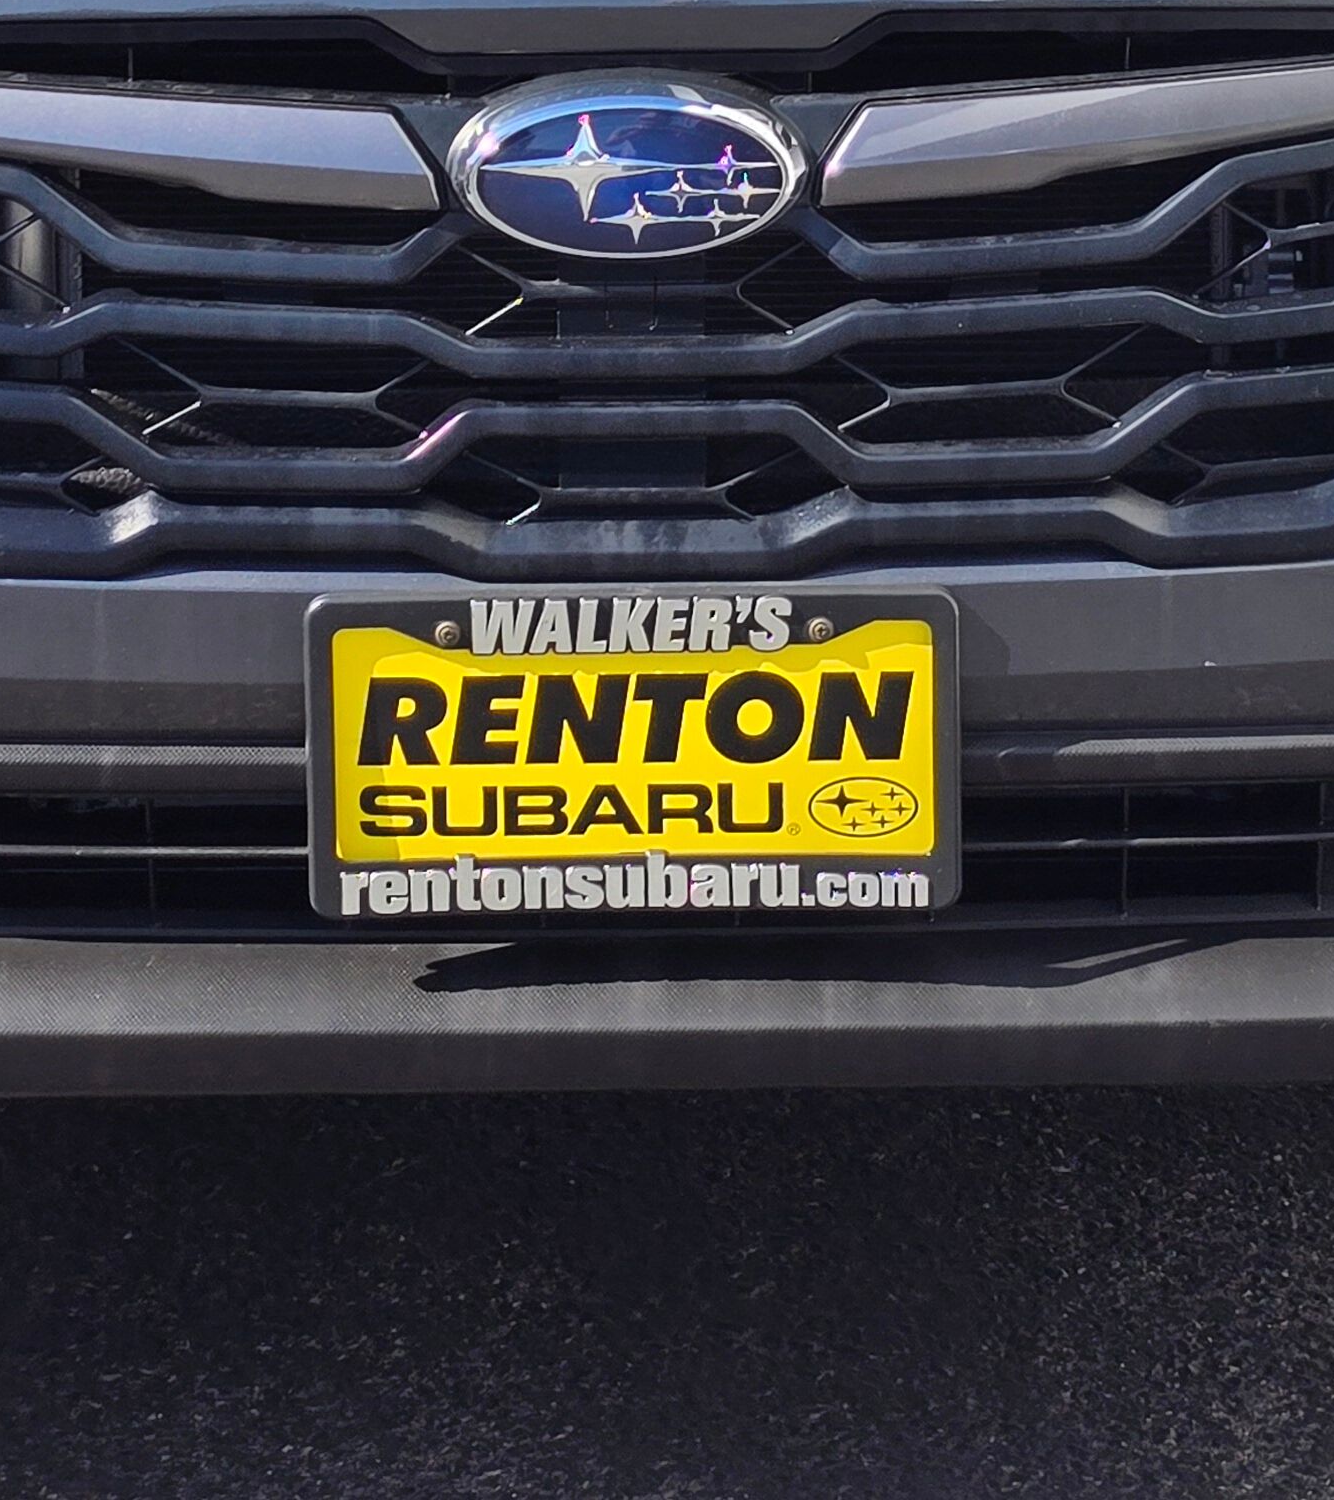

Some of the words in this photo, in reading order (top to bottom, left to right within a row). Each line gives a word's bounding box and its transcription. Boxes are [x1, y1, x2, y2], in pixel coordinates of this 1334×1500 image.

[469, 595, 792, 655] WALKER'S
[357, 670, 914, 766] RENTON
[359, 782, 784, 837] SUBARU
[340, 849, 930, 916] rentonsubaru.com
